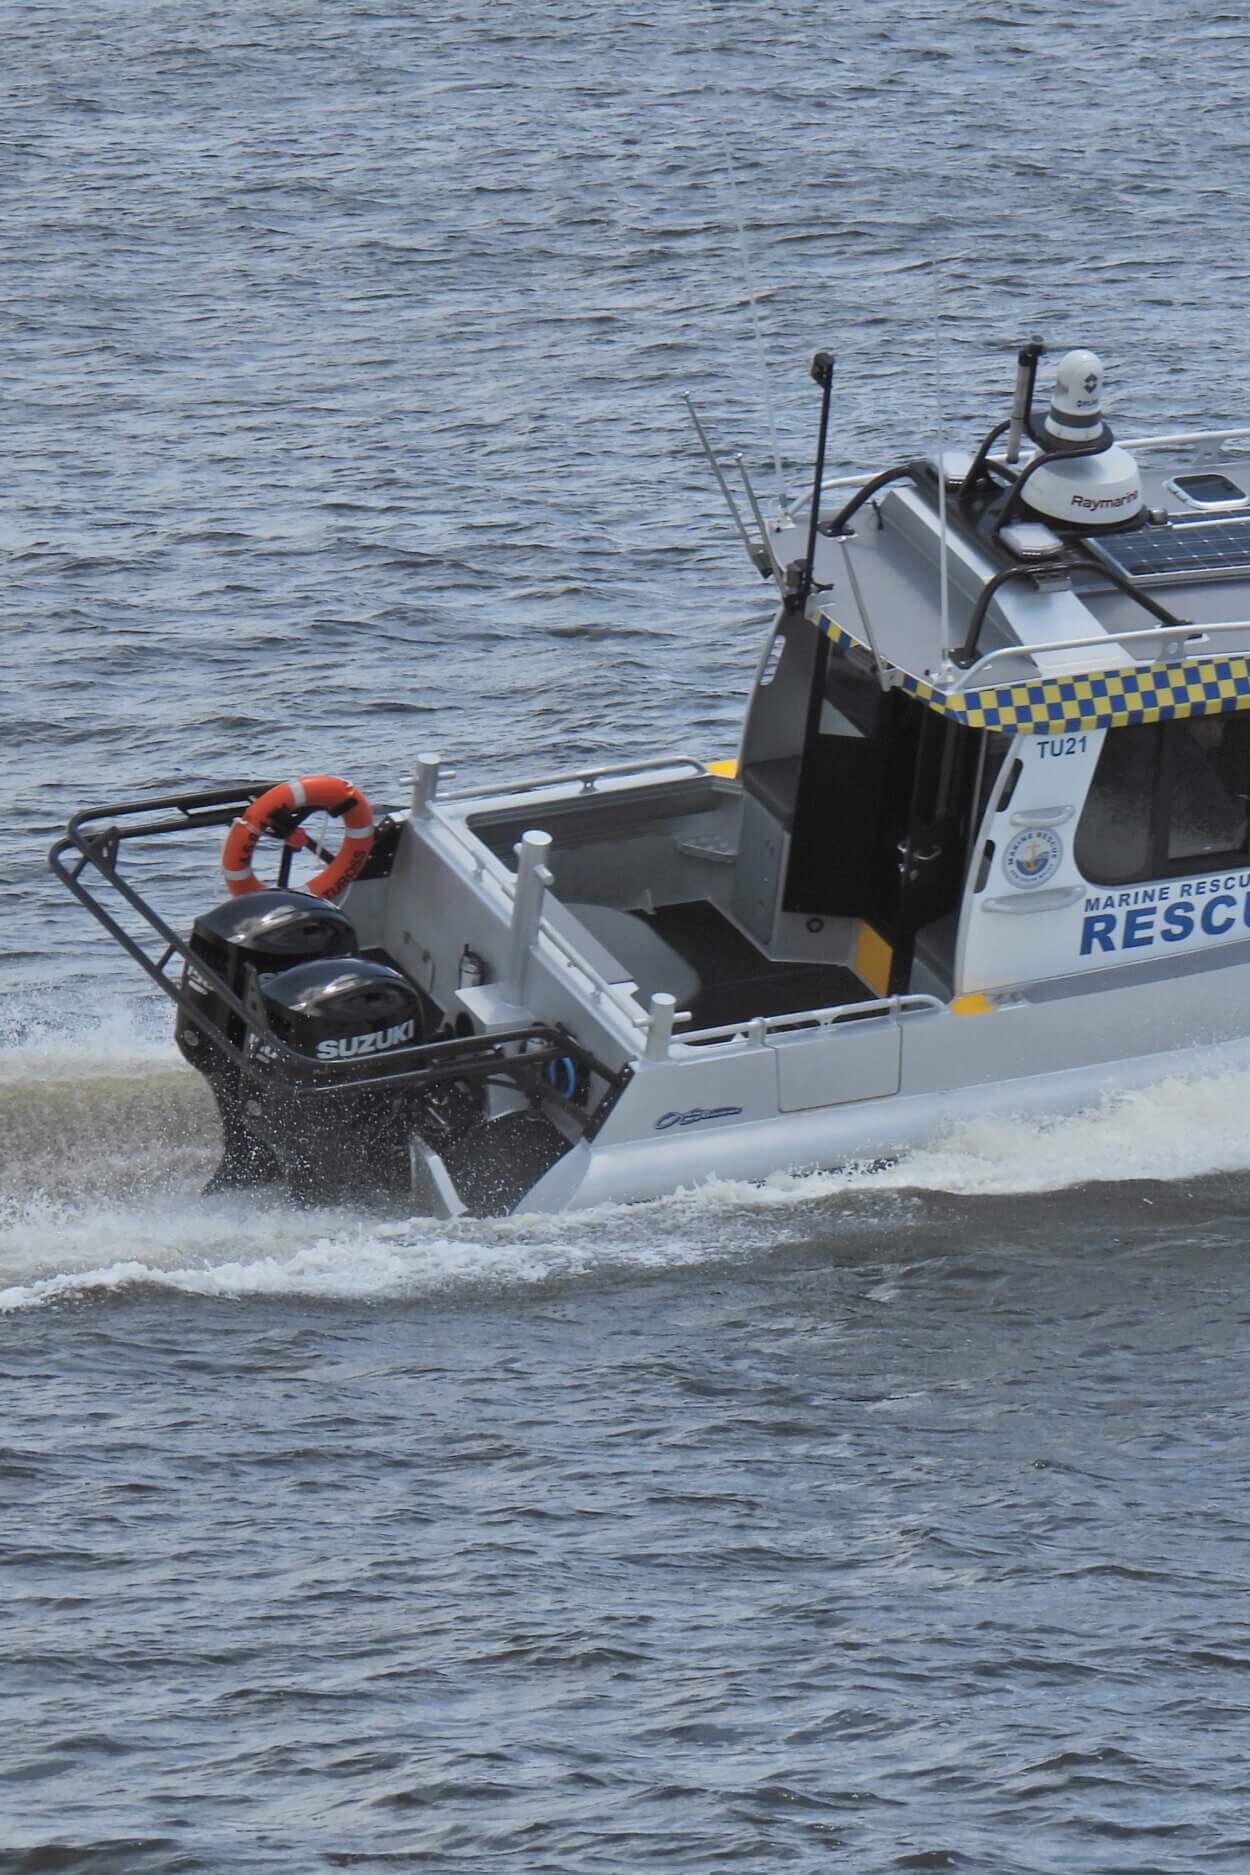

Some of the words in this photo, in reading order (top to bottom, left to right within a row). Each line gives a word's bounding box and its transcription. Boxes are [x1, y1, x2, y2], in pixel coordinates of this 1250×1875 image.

[1072, 489, 1138, 511] Raymarin
[1036, 735, 1087, 759] TU21
[1084, 886, 1171, 913] MARINE
[315, 1019, 415, 1060] SUZUKI
